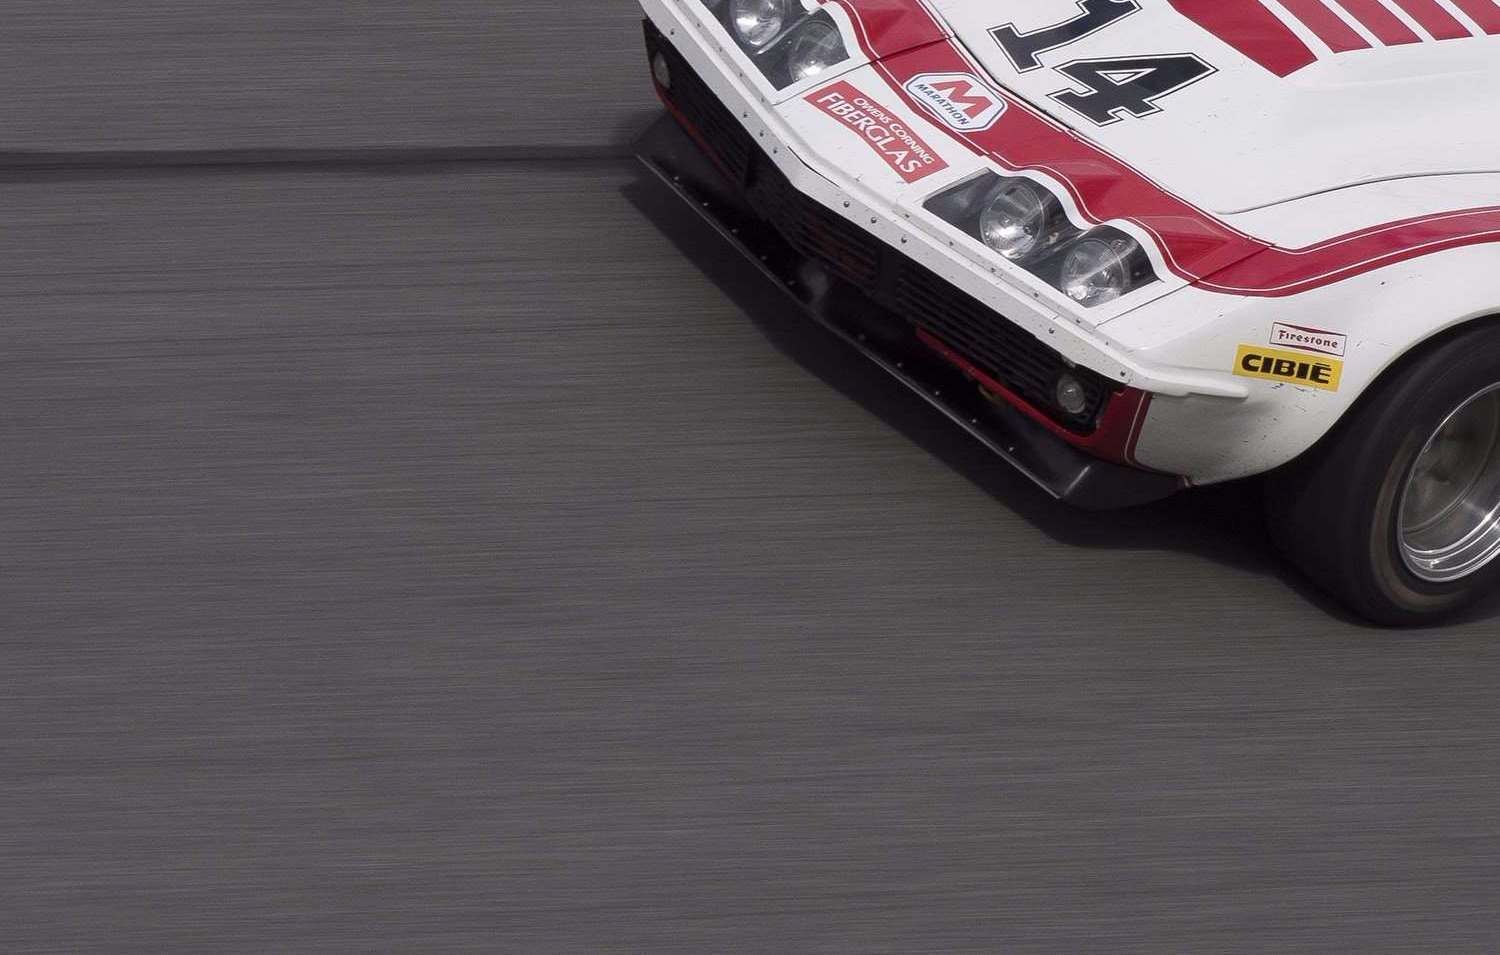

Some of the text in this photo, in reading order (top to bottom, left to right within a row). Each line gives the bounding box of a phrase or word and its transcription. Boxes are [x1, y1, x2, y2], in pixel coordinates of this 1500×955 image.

[914, 83, 970, 126] MARATHON
[928, 79, 994, 120] M
[817, 92, 922, 173] FIBERGLAS
[853, 97, 935, 164] OWENS CORNING
[1278, 329, 1339, 348] Firestone
